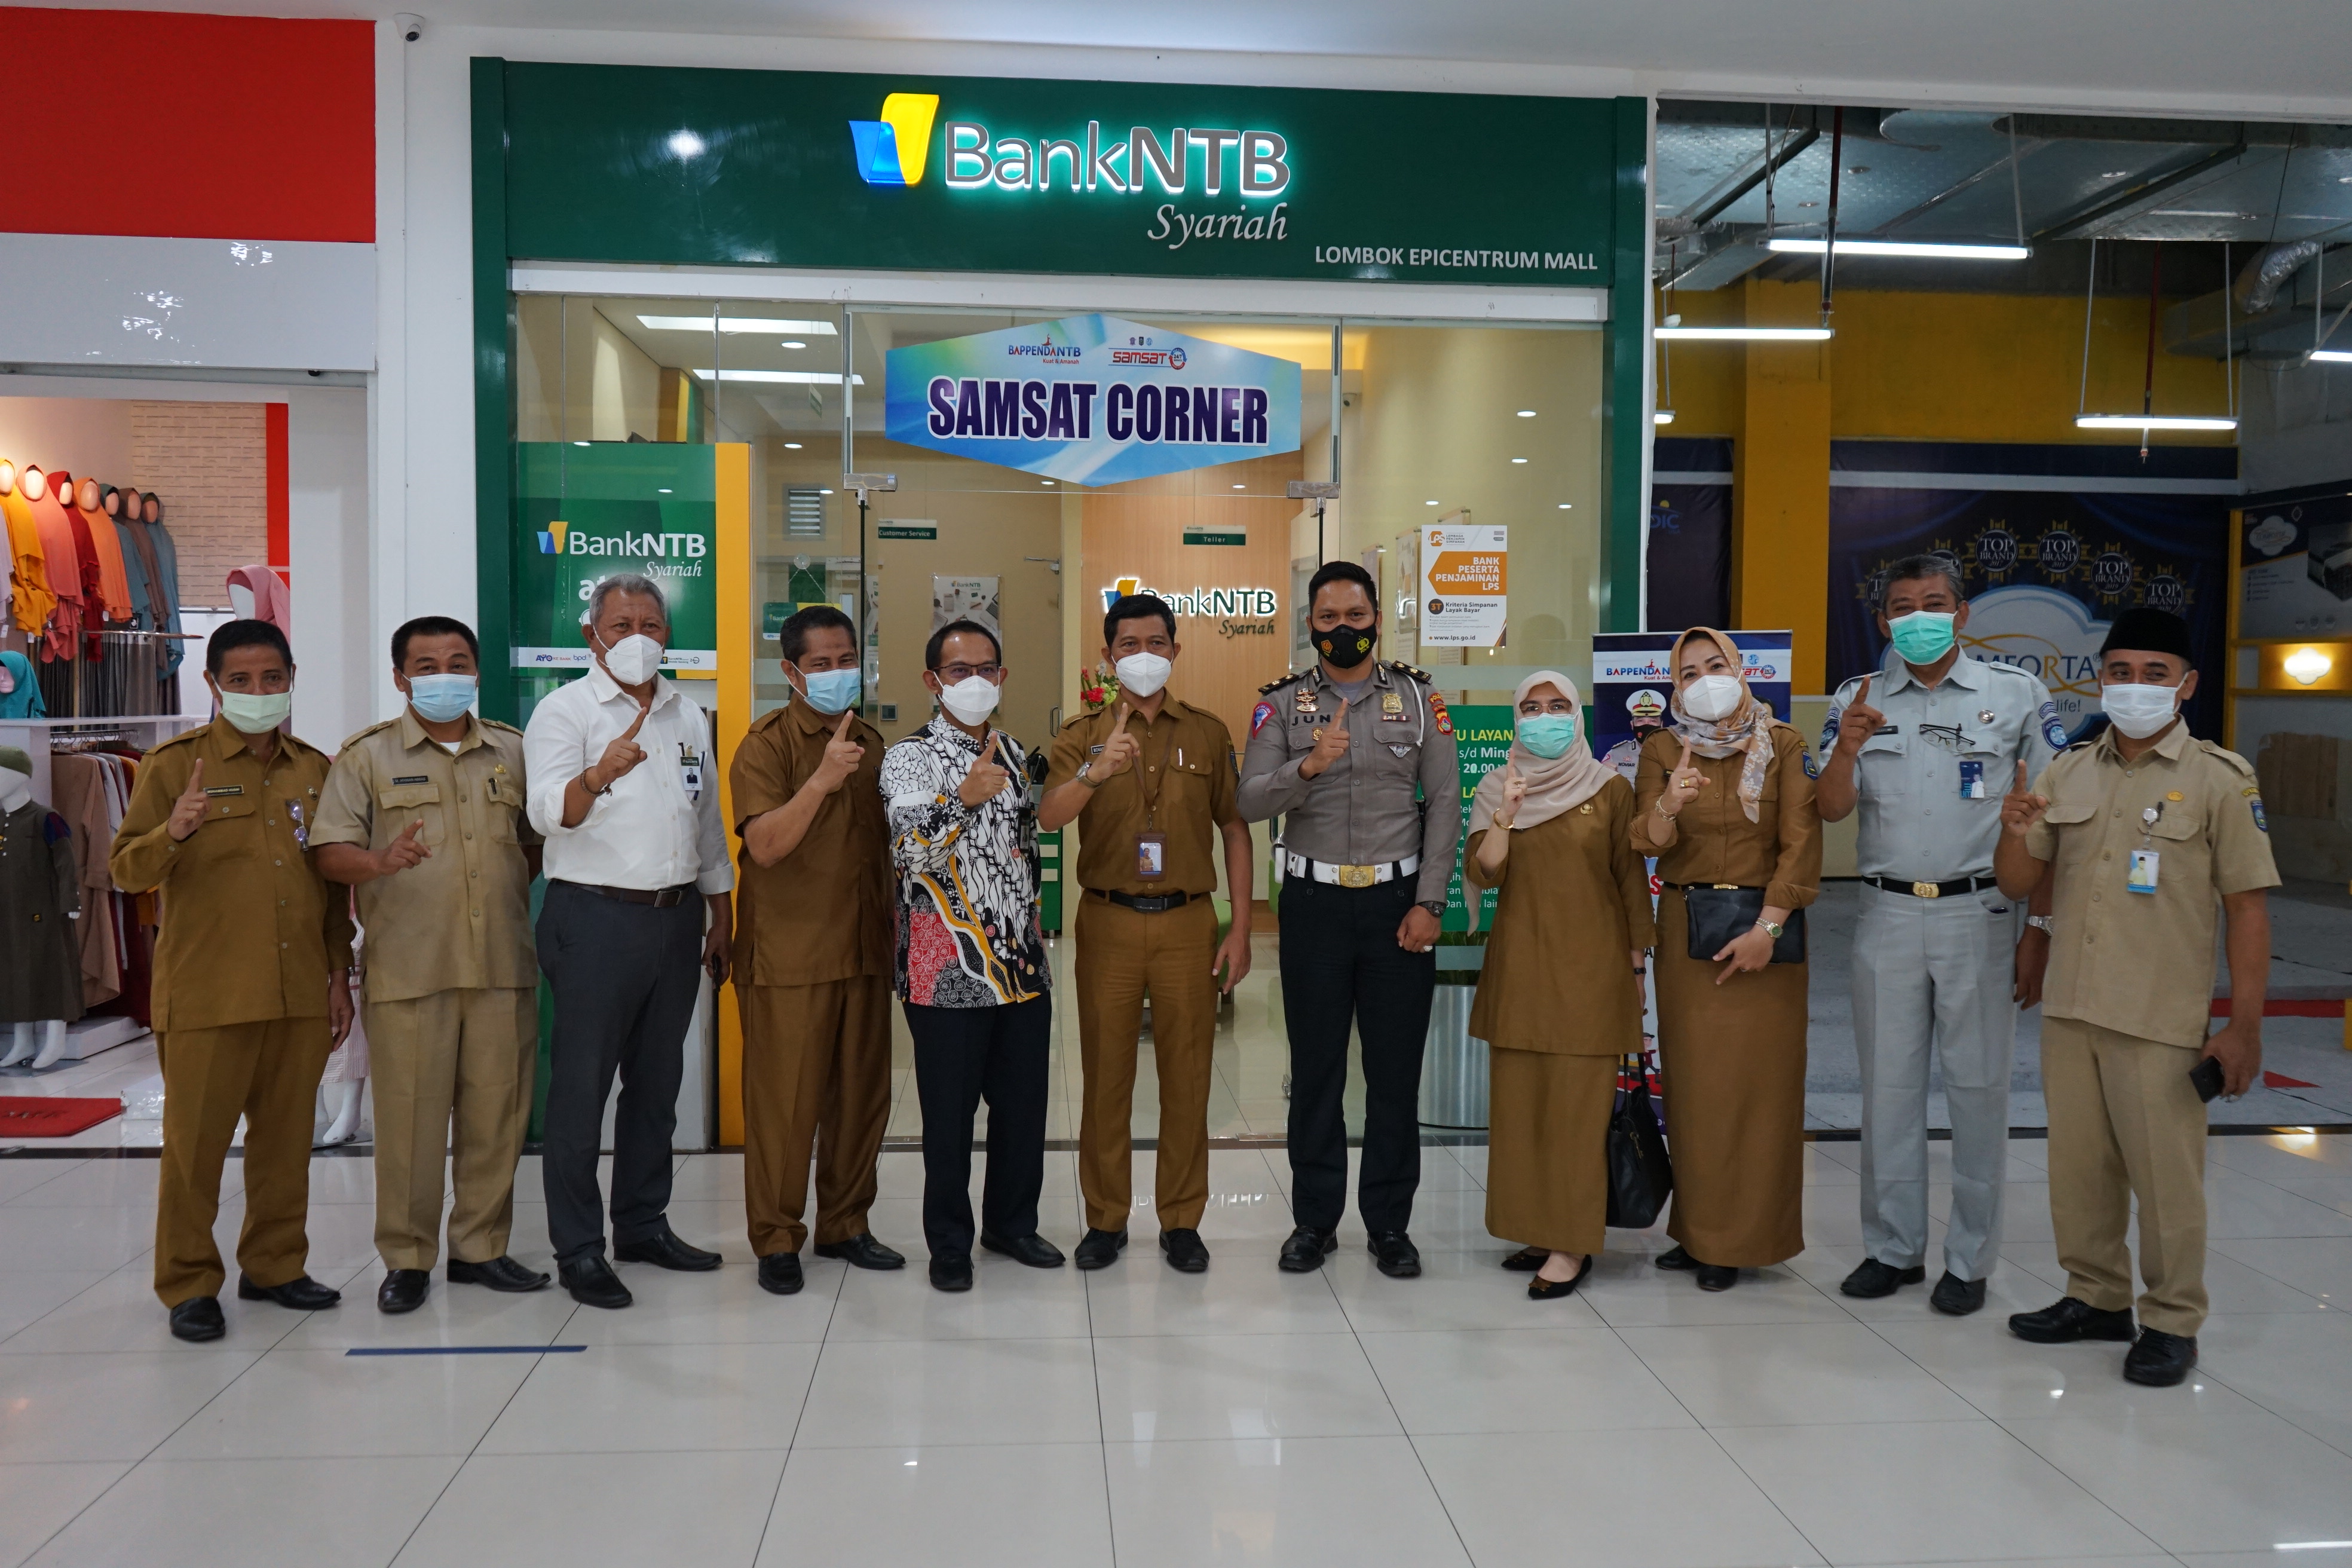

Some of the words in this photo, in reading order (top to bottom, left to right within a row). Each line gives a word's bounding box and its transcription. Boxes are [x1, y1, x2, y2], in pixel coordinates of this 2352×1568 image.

[945, 120, 1291, 196] BankNTB
[1147, 203, 1288, 250] Syariah
[1315, 246, 1404, 265] LOMBOK
[1410, 249, 1539, 268] EPICENTRUM
[1544, 252, 1598, 270] MALL
[929, 378, 1097, 440] SAMSAT
[1107, 382, 1268, 444] CORNER
[569, 531, 706, 558] BankNTB
[1979, 538, 2014, 552] TOP
[2042, 538, 2075, 552] TOP
[1979, 552, 2014, 561] BRAND
[2042, 553, 2077, 561] BRAND
[642, 560, 702, 581] Syariah
[1459, 565, 1500, 574] PESERTA
[2095, 561, 2129, 575] TOP
[1435, 574, 1499, 582] PENJAMINAN
[2095, 574, 2129, 583] BRAND
[1483, 582, 1500, 590] LPS
[2148, 583, 2181, 597] TOP
[2148, 597, 2180, 605] BRAND
[1218, 619, 1275, 639] Syariah
[1459, 747, 1477, 760] s/d
